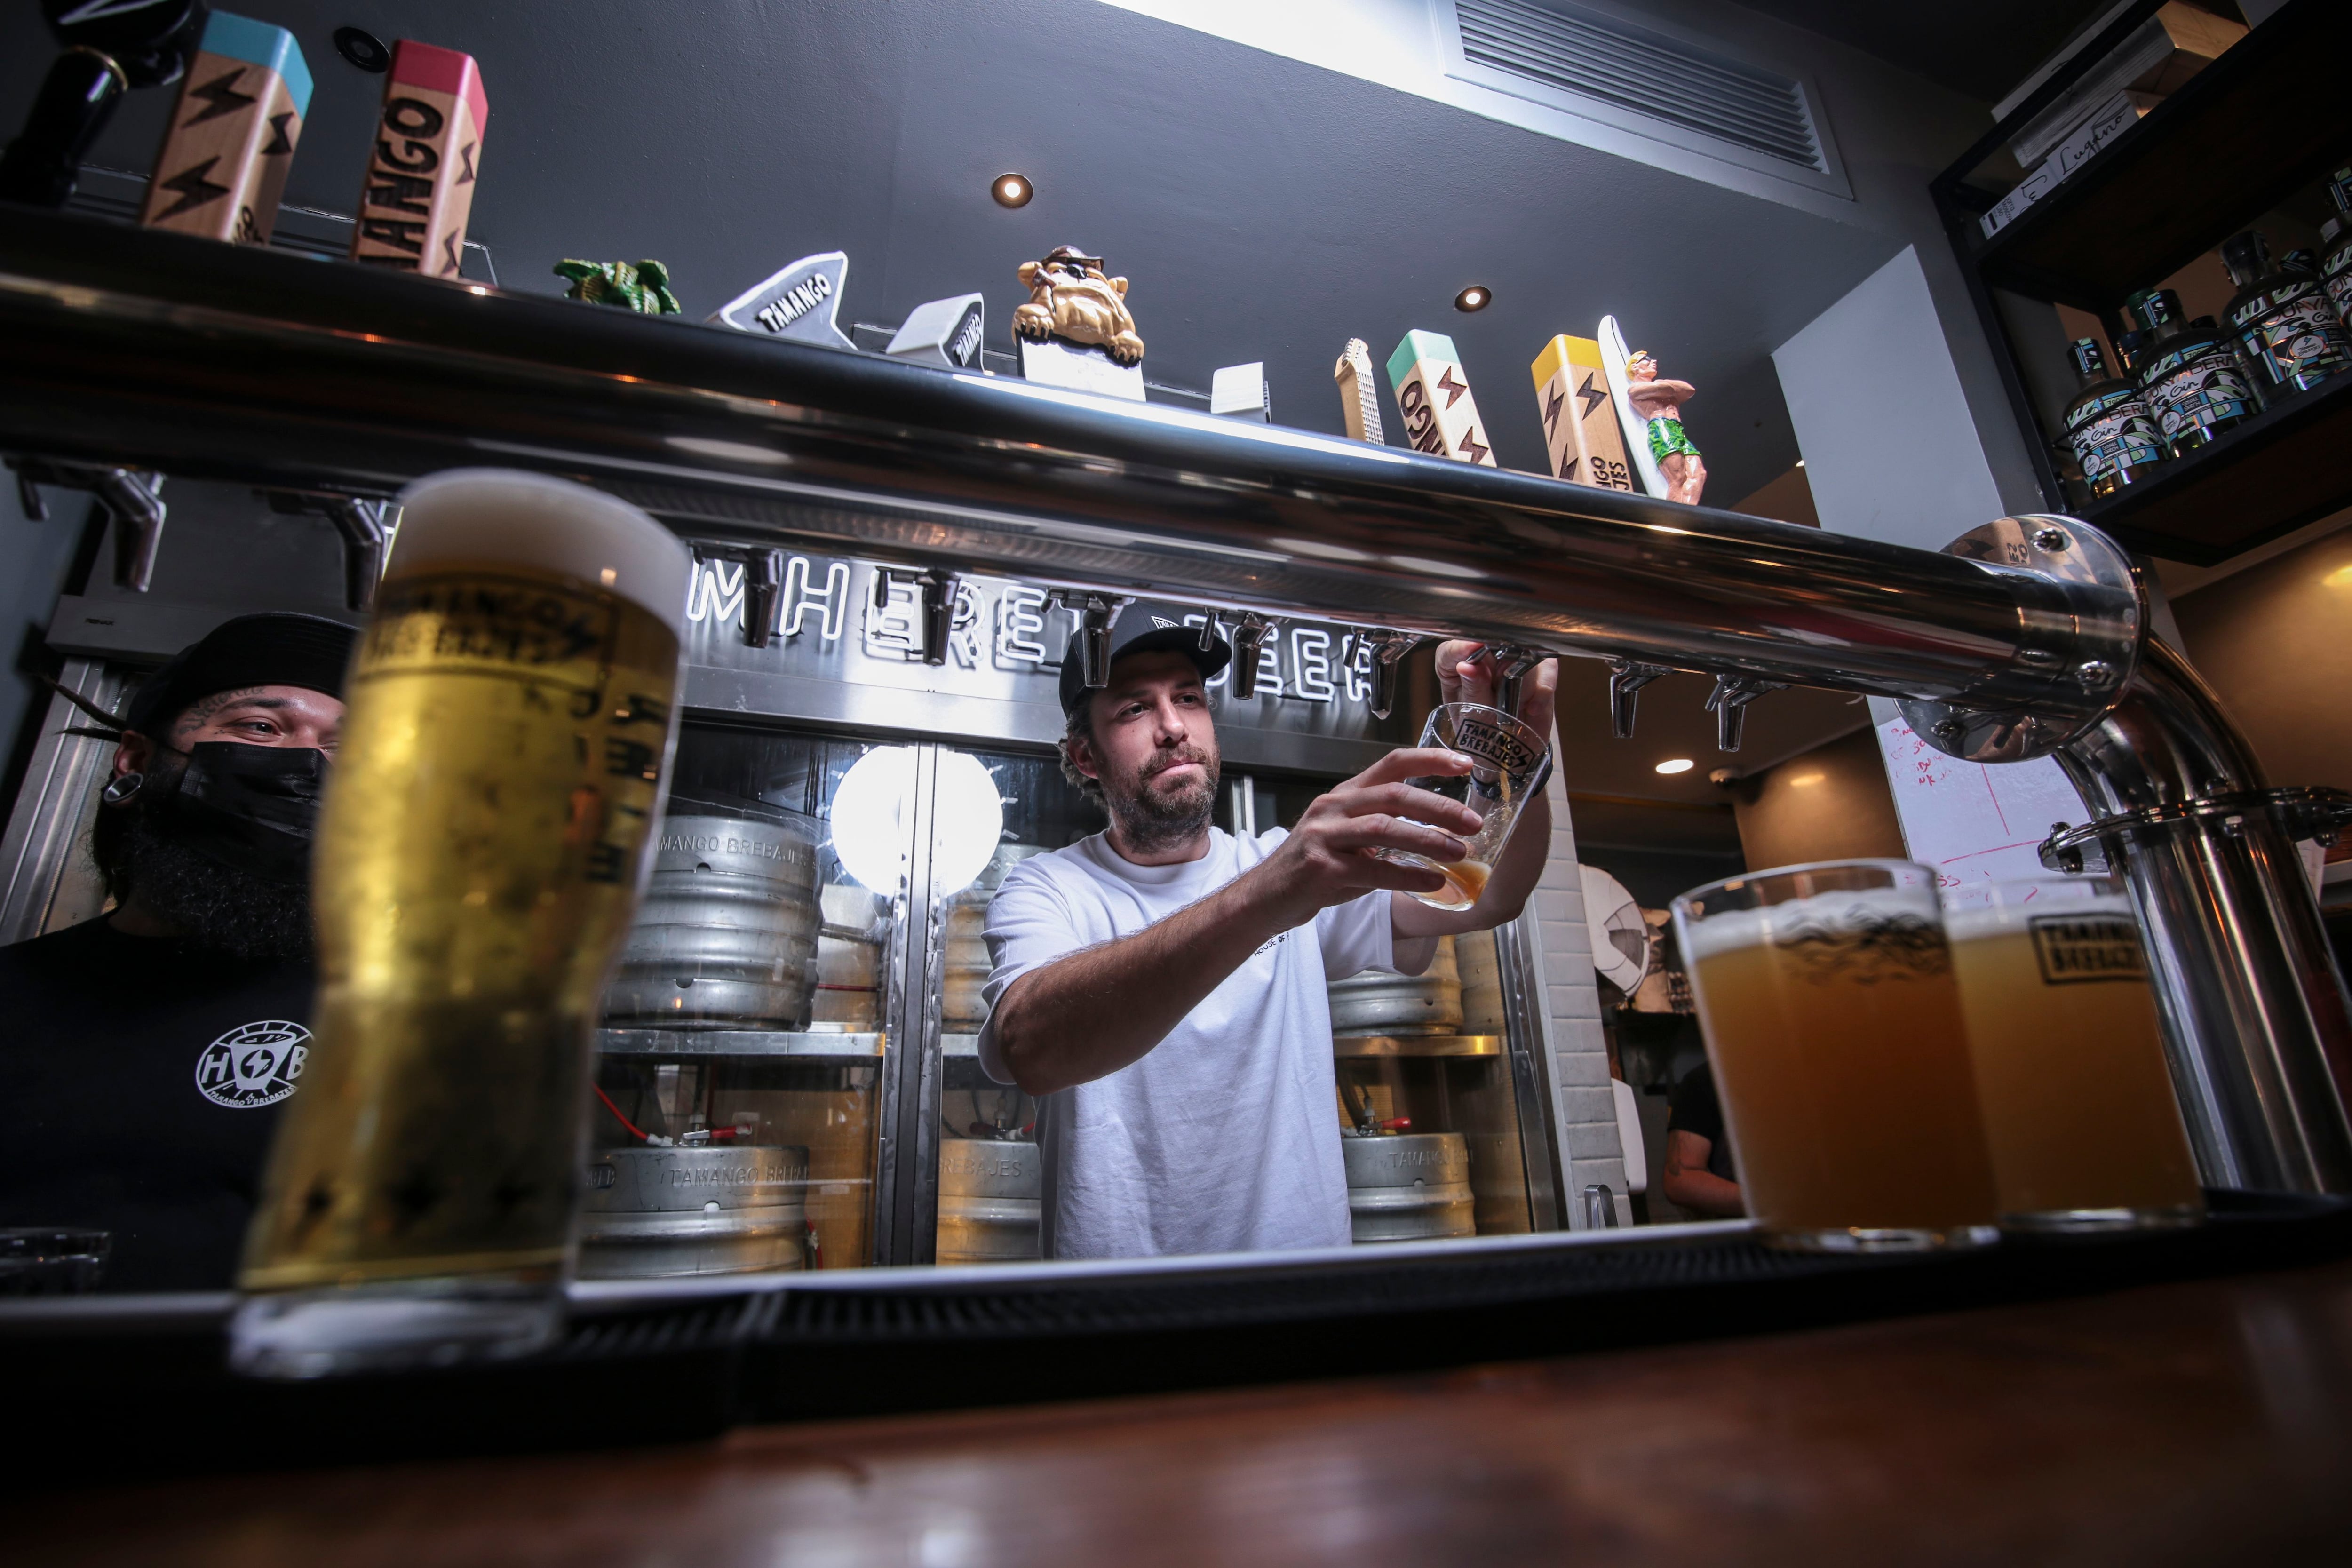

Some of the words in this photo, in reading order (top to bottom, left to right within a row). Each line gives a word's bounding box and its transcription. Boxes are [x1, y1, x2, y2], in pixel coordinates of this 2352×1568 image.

[758, 273, 832, 332] TAMANGO
[955, 314, 982, 367] TAMANGO
[2170, 382, 2198, 397] Gin
[2090, 425, 2117, 441] Gin
[1459, 734, 1515, 766] BREBAJES
[1465, 724, 1522, 756] TAMANGO
[1254, 939, 1276, 957] HOUSE
[209, 1091, 245, 1106] TAMANGO
[253, 1086, 295, 1105] BREBAJES
[670, 1166, 759, 1186] TAMANGO
[940, 1158, 1022, 1177] REBAJES
